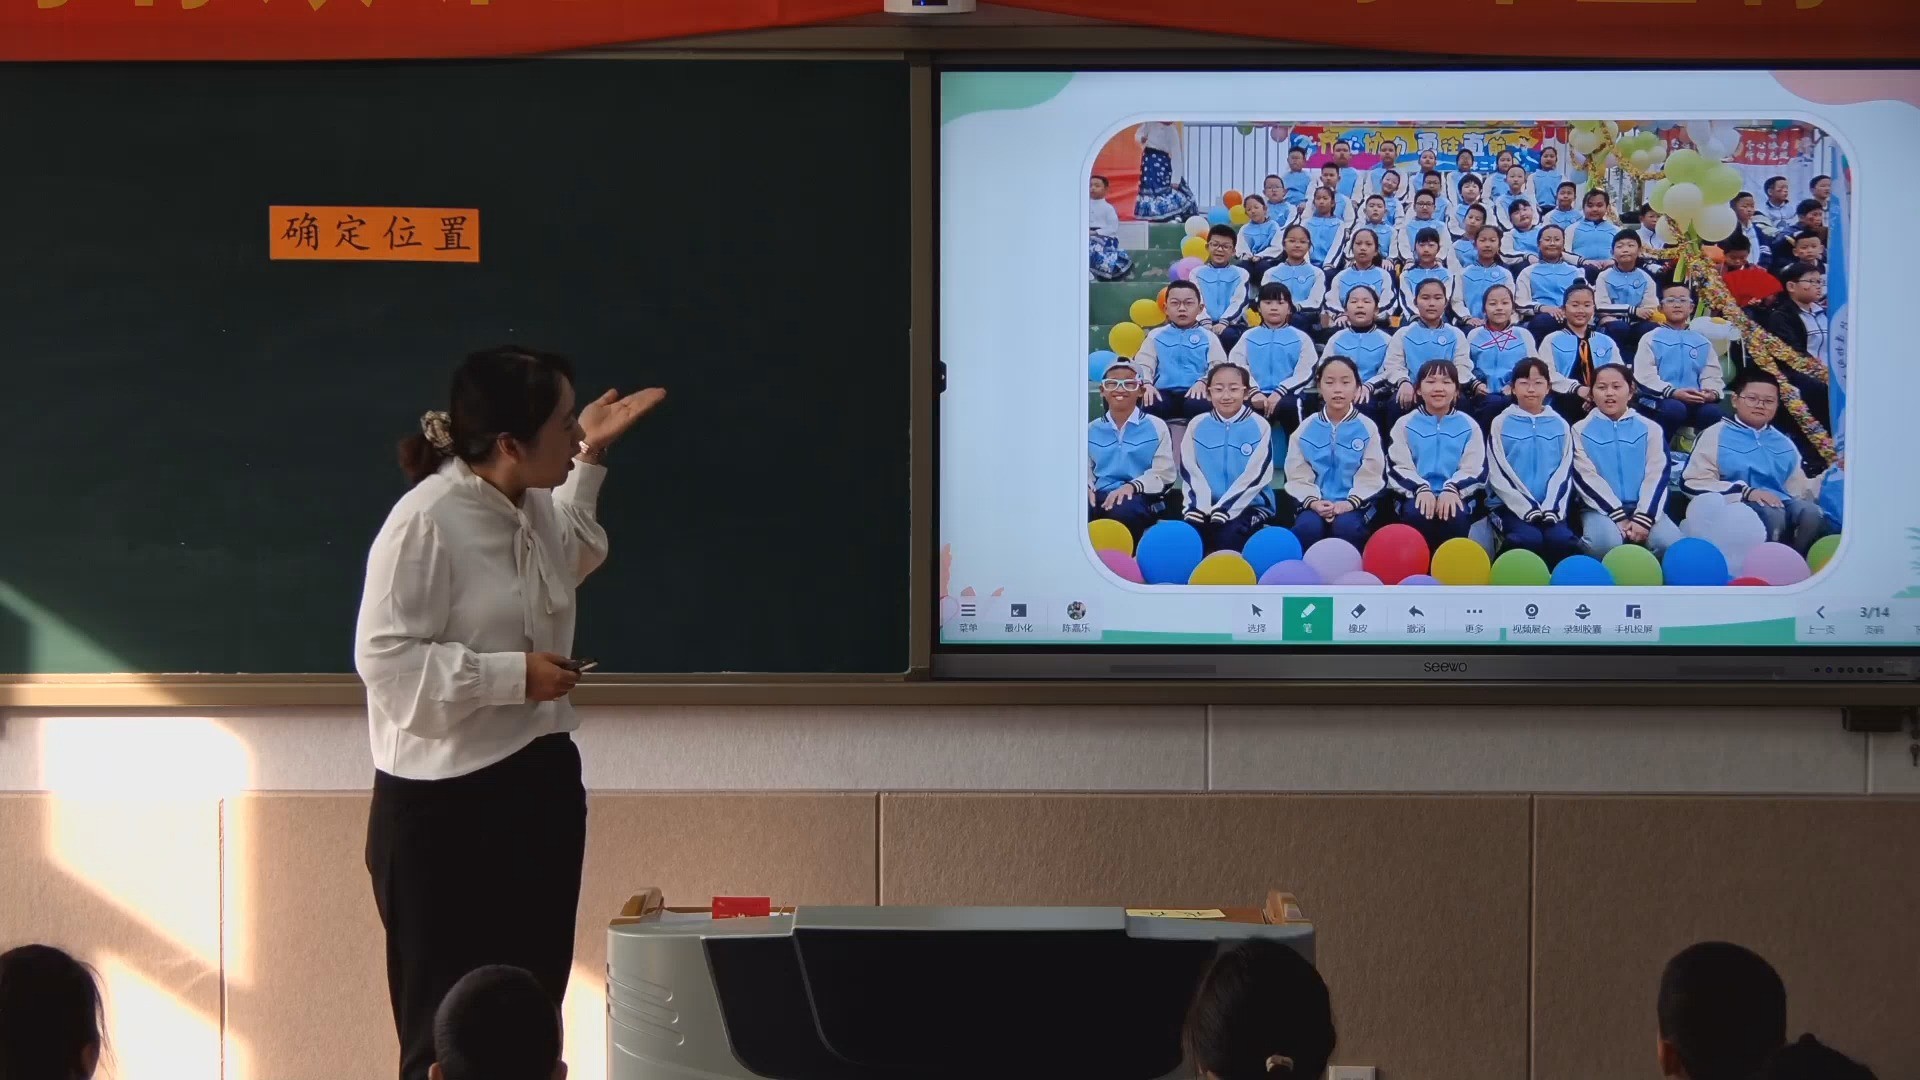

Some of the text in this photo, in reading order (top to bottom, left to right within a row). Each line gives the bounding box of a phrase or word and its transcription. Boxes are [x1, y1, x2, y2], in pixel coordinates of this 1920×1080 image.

[281, 212, 471, 251] 确定位置
[1859, 606, 1890, 618] 3/14
[959, 623, 978, 633] 菜单
[1004, 623, 1033, 633] 最小化
[1062, 623, 1091, 633] 陈嘉乐
[1247, 623, 1267, 633] 选择
[1302, 623, 1313, 634] 笔
[1348, 624, 1368, 633] 橡皮
[1465, 625, 1484, 634] 更多
[1512, 624, 1551, 634] 视频展台
[1563, 625, 1602, 634] 录制胶囊
[1615, 625, 1653, 634] 手机投屏
[1807, 625, 1836, 635] 上一页
[1423, 661, 1468, 672] seewo
